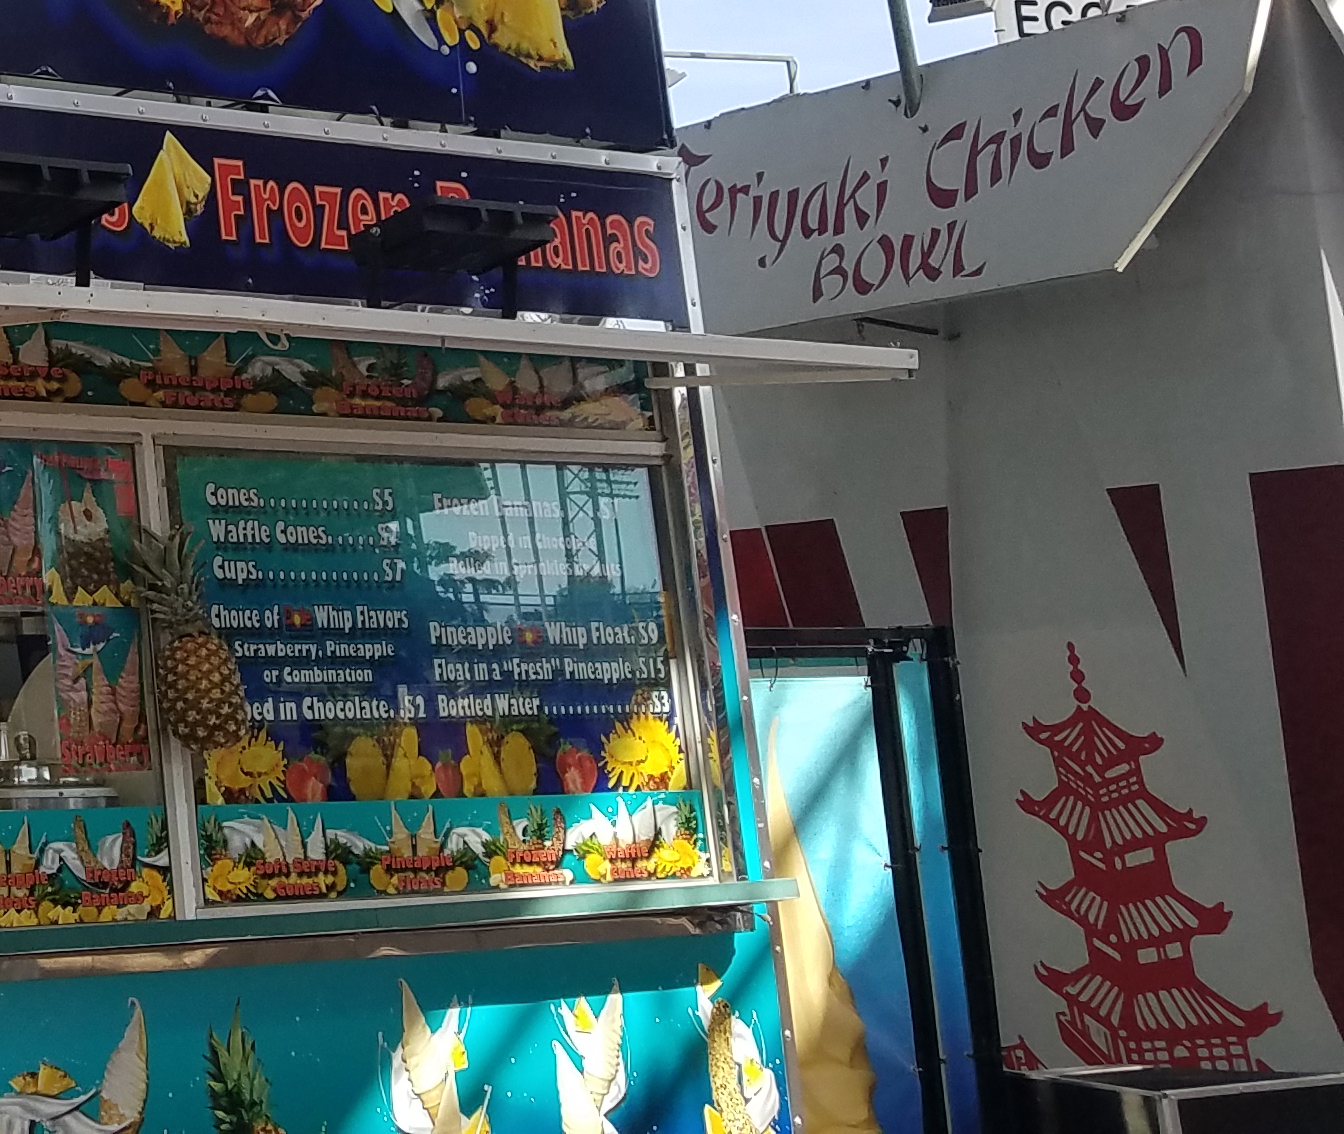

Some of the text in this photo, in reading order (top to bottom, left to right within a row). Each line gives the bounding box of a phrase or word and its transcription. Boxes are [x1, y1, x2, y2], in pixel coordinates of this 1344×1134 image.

[923, 23, 1206, 211] Chicken
[811, 219, 989, 306] BOWL
[140, 370, 255, 393] Pineapple
[164, 391, 236, 410] Floats
[335, 399, 430, 419] Bananas
[205, 482, 259, 508] Cones
[431, 492, 494, 516] Frozen
[207, 519, 327, 546] Waffle Cones
[212, 555, 258, 585] Cups
[211, 604, 262, 629] Choice
[264, 604, 280, 629] of
[314, 604, 354, 634] Whip
[355, 604, 409, 629] Flavors
[428, 621, 512, 650] Pineapple
[544, 621, 589, 650] Whip
[234, 640, 396, 661] Strawberry, Pineapple
[263, 666, 373, 684] or Combination
[433, 657, 471, 682] Float
[474, 658, 488, 682] in
[491, 662, 503, 682] a
[563, 657, 632, 686] Pineapple
[278, 696, 298, 721] in
[437, 693, 491, 717] Bottled
[494, 693, 541, 717] Water
[61, 739, 150, 767] Strawberry
[380, 852, 454, 871] Pineapple
[507, 847, 557, 864] Frozen
[603, 843, 650, 860] Waffle
[84, 866, 137, 883] Frozen
[255, 855, 336, 875] Soft Serve
[610, 863, 650, 879] Cones
[396, 874, 444, 891] Floats
[503, 868, 565, 885] Bananas
[80, 890, 145, 907] Bananas
[274, 880, 320, 897] Cones
